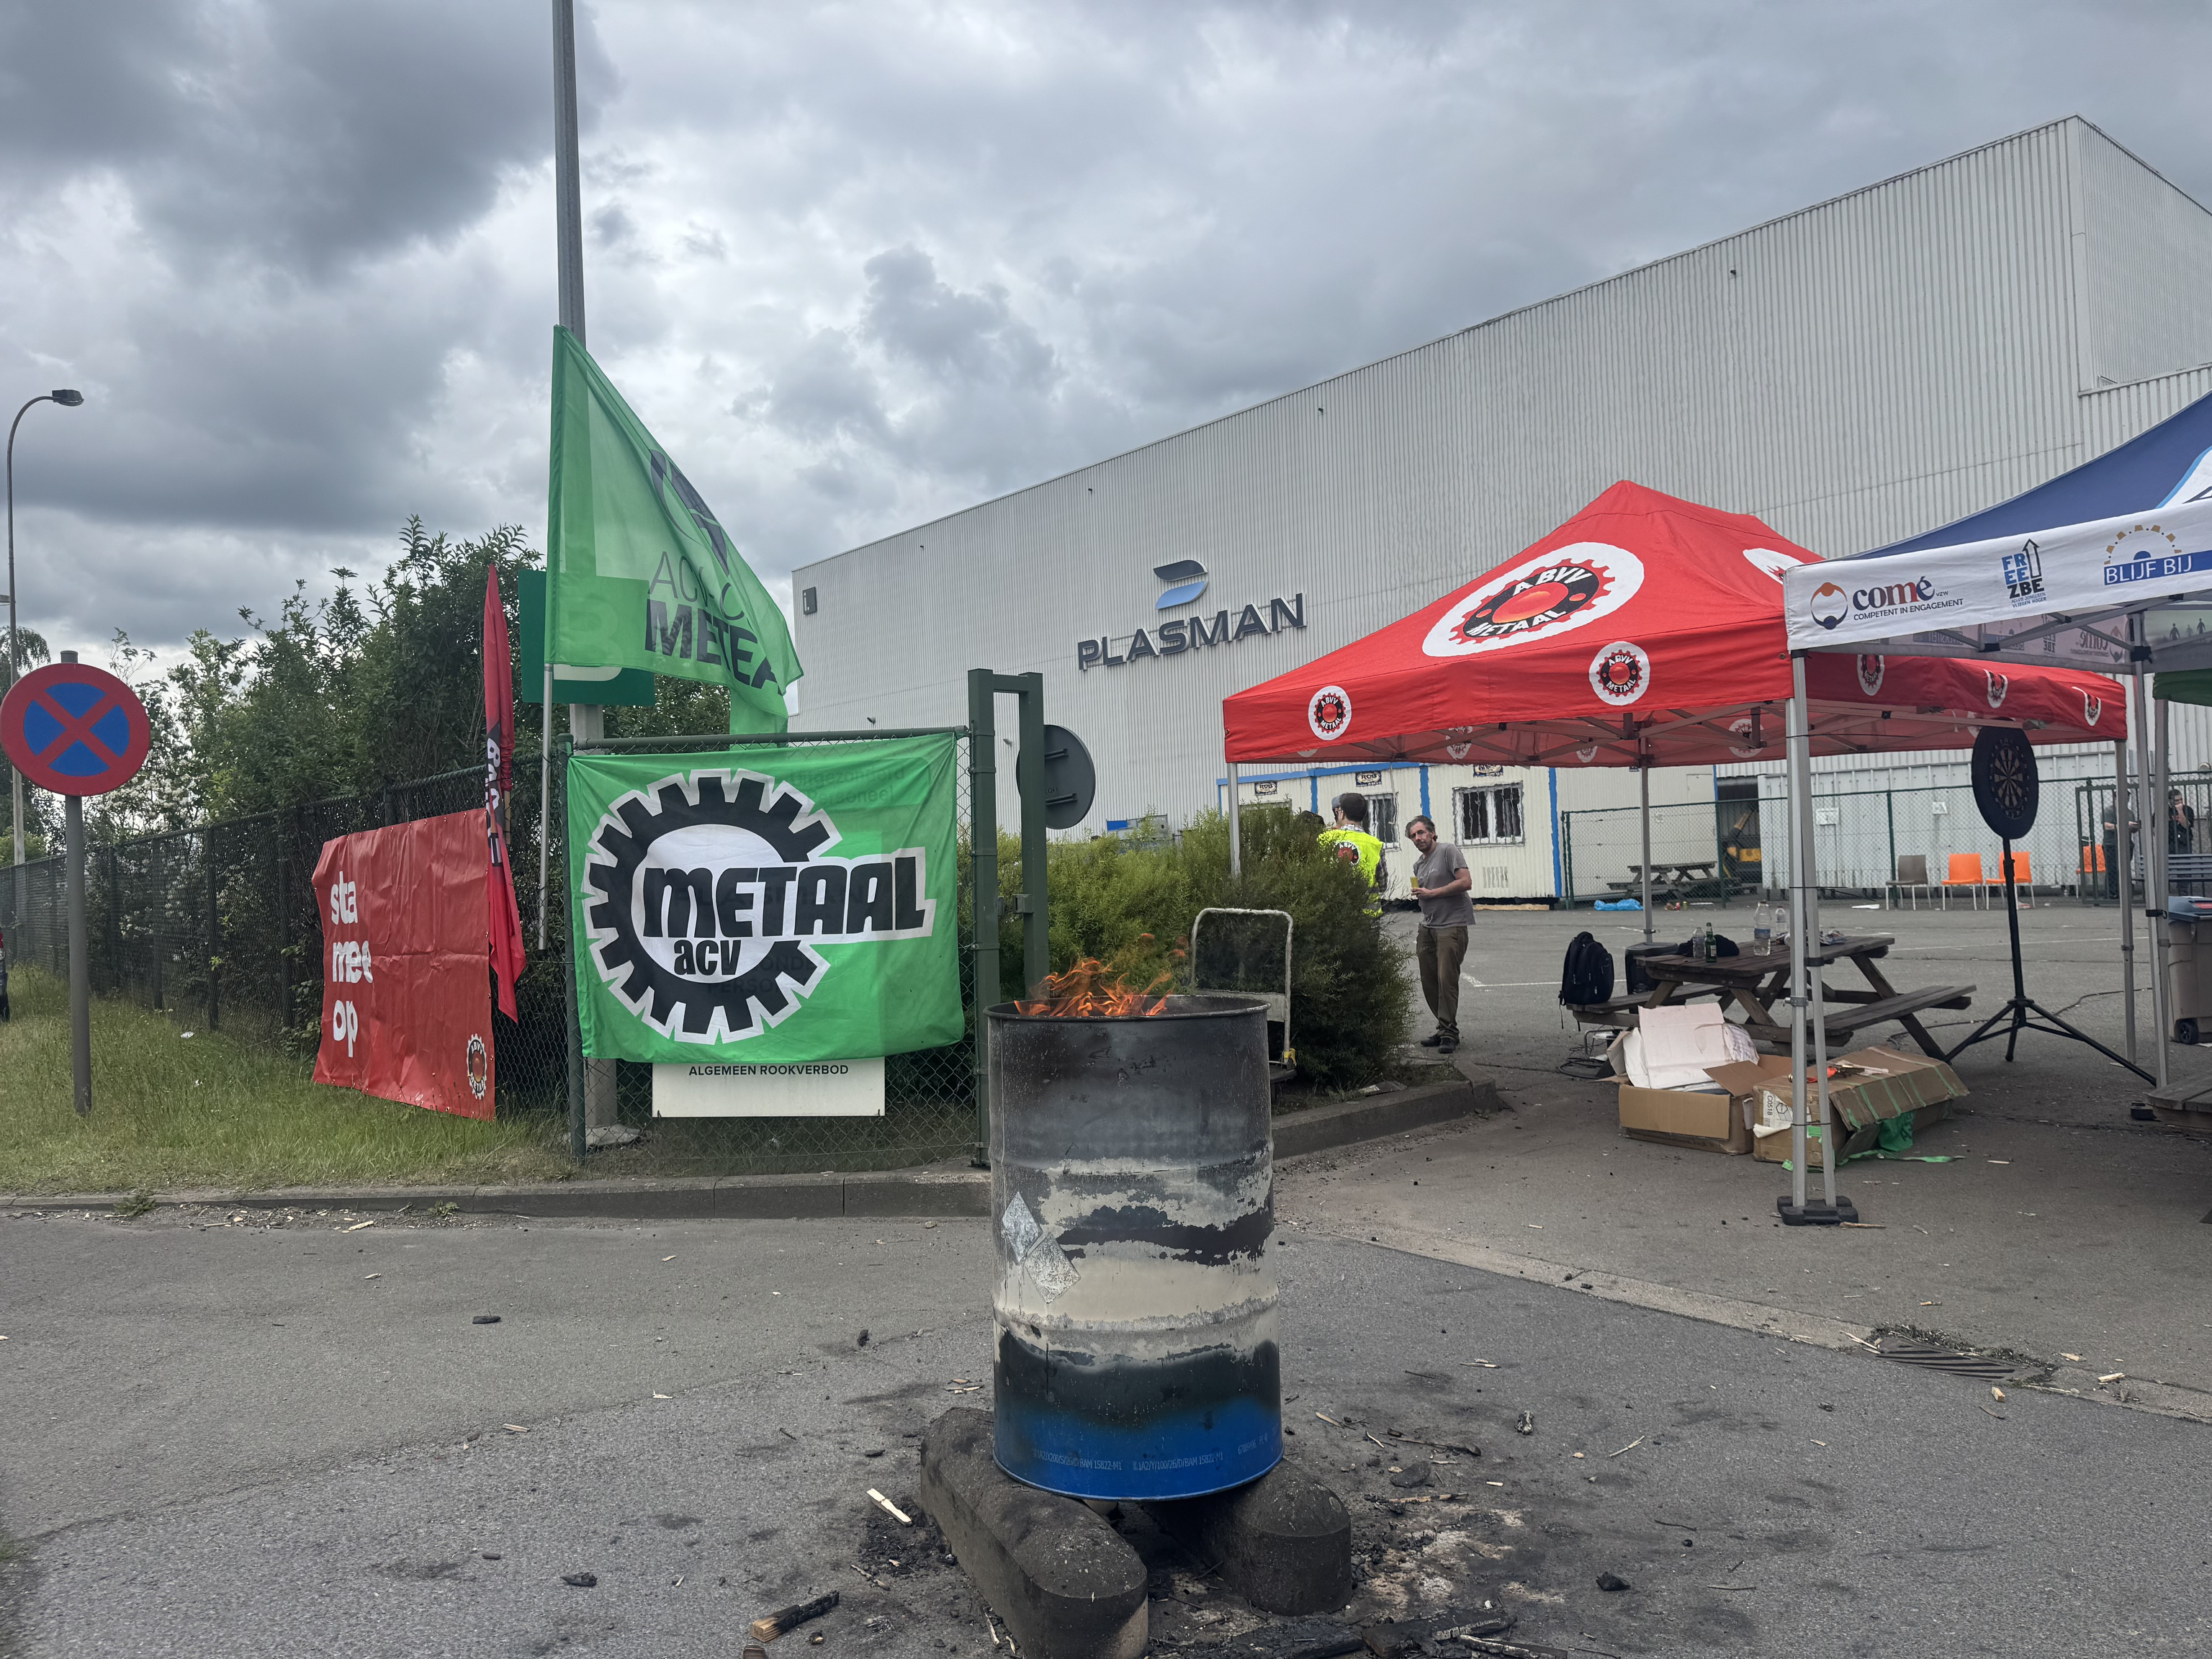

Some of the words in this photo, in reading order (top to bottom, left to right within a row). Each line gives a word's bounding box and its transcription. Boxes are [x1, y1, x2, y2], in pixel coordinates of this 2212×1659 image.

[1513, 567, 1592, 596] ABVV
[2106, 561, 2157, 584] BLIJF
[2164, 555, 2192, 575] BIJ
[1853, 576, 1935, 611] comé
[2008, 577, 2045, 599] ZBE
[1466, 610, 1567, 637] METAAL
[1854, 608, 1899, 621] COMPETENT
[1910, 598, 1964, 613] ENGAGEMENT
[1077, 593, 1307, 670] PLASMAN
[1609, 655, 1634, 666] ABVV
[1606, 679, 1636, 692] METAAL
[1321, 696, 1339, 707] ABVV
[1321, 717, 1341, 729] METAAL
[331, 871, 359, 925] sta
[643, 857, 926, 938] METAAL
[332, 940, 373, 984] mee
[674, 939, 741, 976] acv
[333, 999, 359, 1058] op
[688, 1066, 756, 1076] ALGEMEEN
[760, 1065, 849, 1075] ROOKVERBOD
